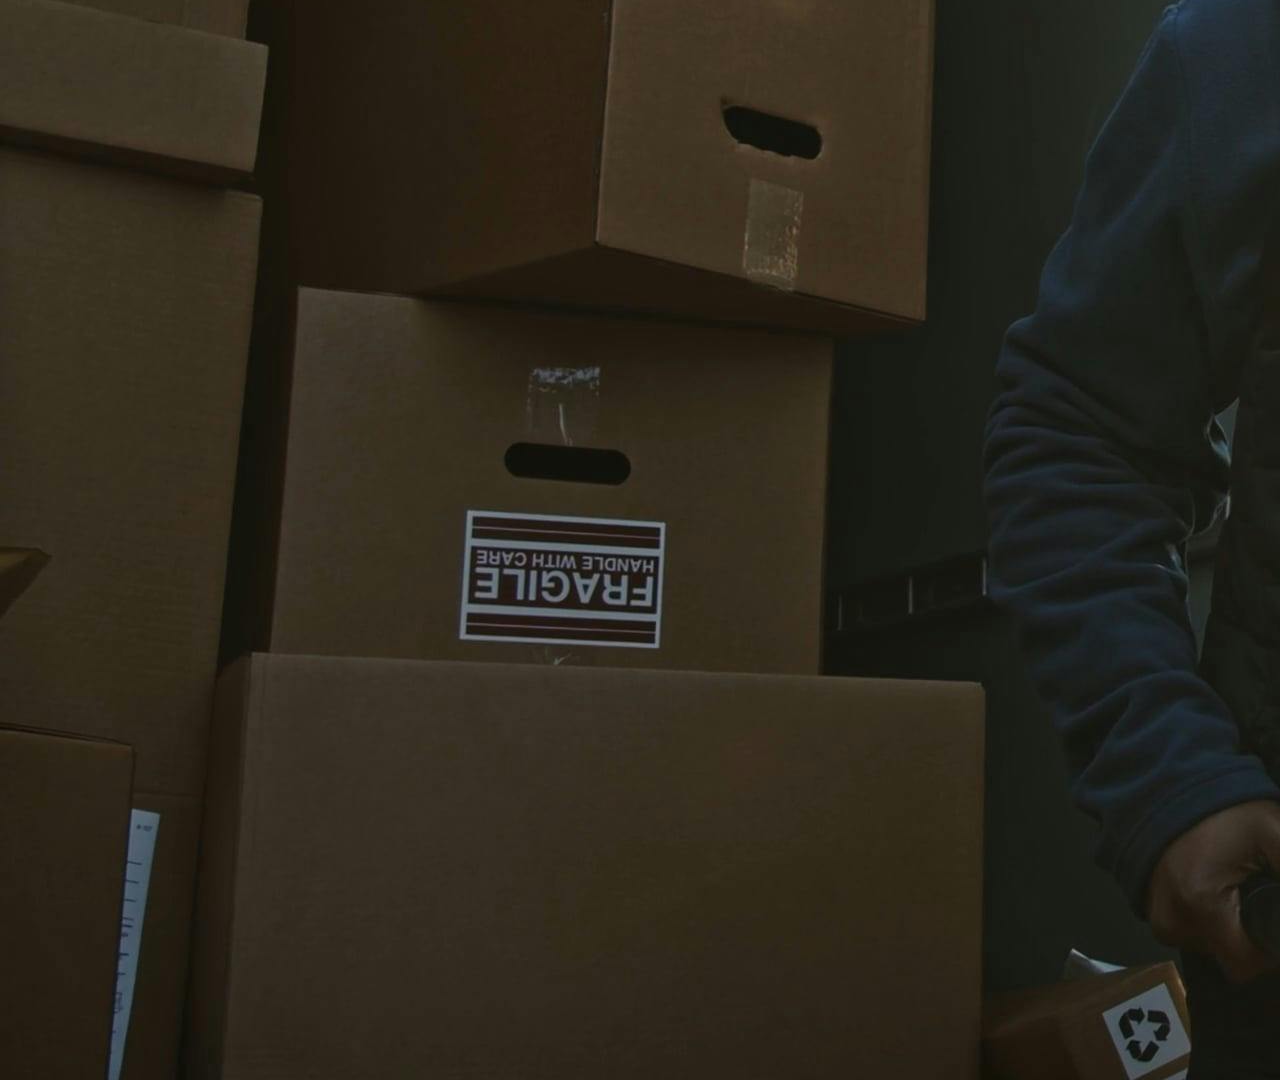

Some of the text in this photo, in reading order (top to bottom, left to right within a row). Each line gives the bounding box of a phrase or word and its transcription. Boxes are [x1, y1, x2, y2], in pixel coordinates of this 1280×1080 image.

[475, 549, 655, 573] HANDLE WITH CARE
[474, 567, 654, 607] FRAGILE
